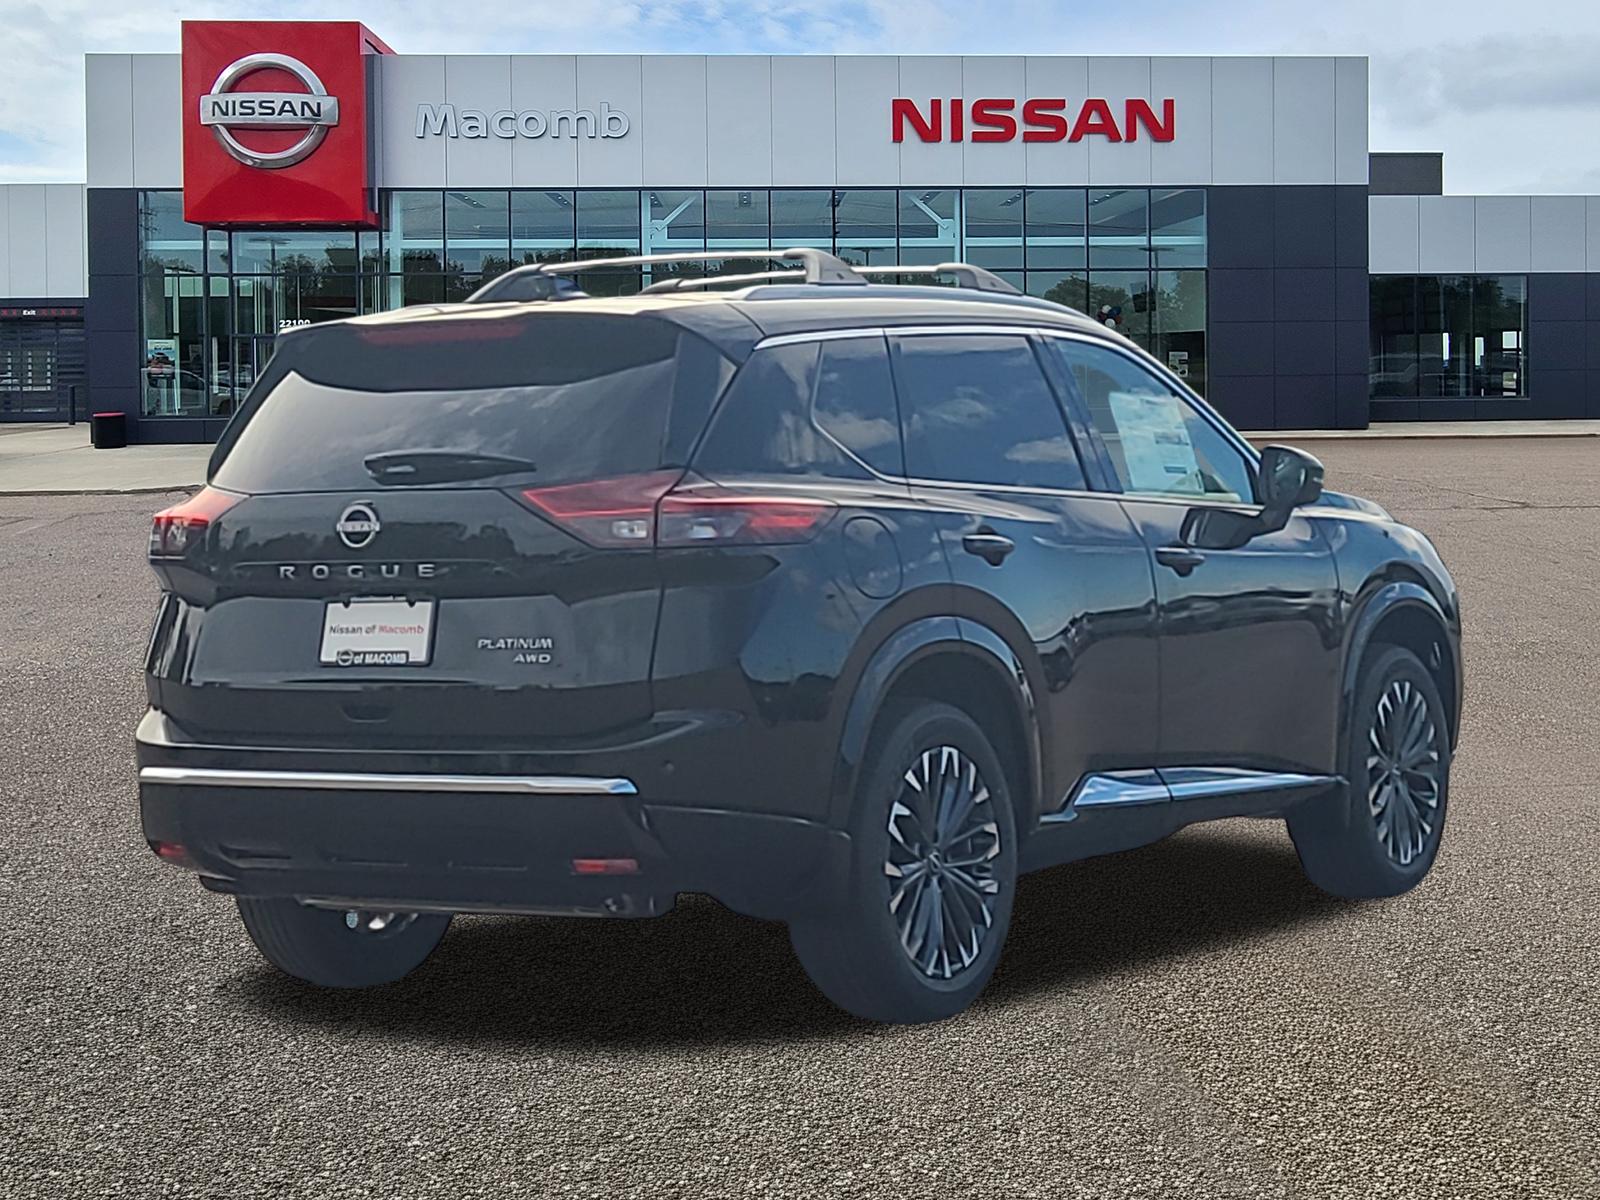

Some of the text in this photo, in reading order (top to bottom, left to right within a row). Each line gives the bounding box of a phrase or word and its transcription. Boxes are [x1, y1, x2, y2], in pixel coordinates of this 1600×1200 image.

[212, 100, 322, 118] NISSAN
[415, 102, 630, 139] Macomb
[891, 98, 1175, 143] NISSAN
[279, 564, 436, 579] ROGUE
[330, 624, 425, 635] Nissan of Macomb
[477, 638, 553, 649] PLATINUM
[354, 653, 408, 664] of MACOMB
[512, 653, 552, 664] AWD
